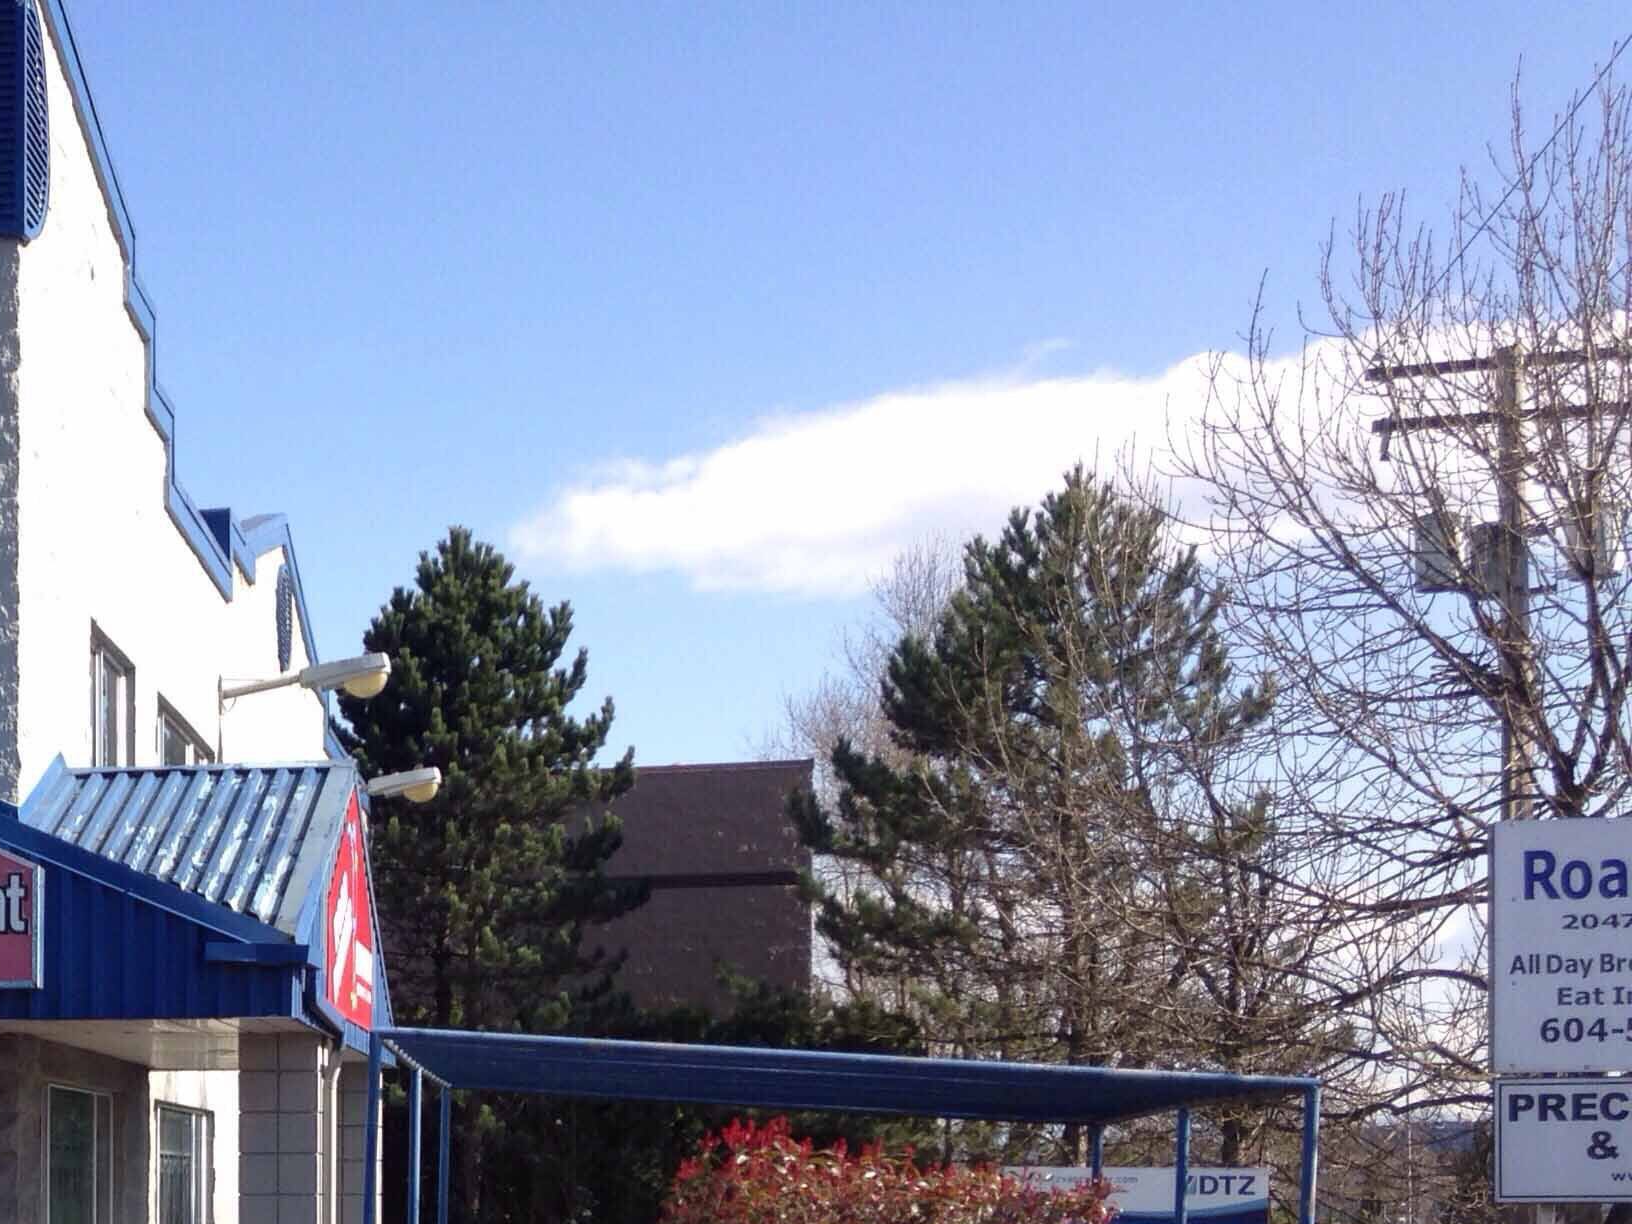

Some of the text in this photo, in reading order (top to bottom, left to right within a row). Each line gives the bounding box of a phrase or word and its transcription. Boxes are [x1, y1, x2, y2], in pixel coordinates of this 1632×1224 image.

[1510, 953, 1632, 979] All Day Br
[1557, 986, 1605, 1006] Eat
[1587, 1130, 1619, 1160] &
[1199, 1175, 1256, 1196] DTZ
